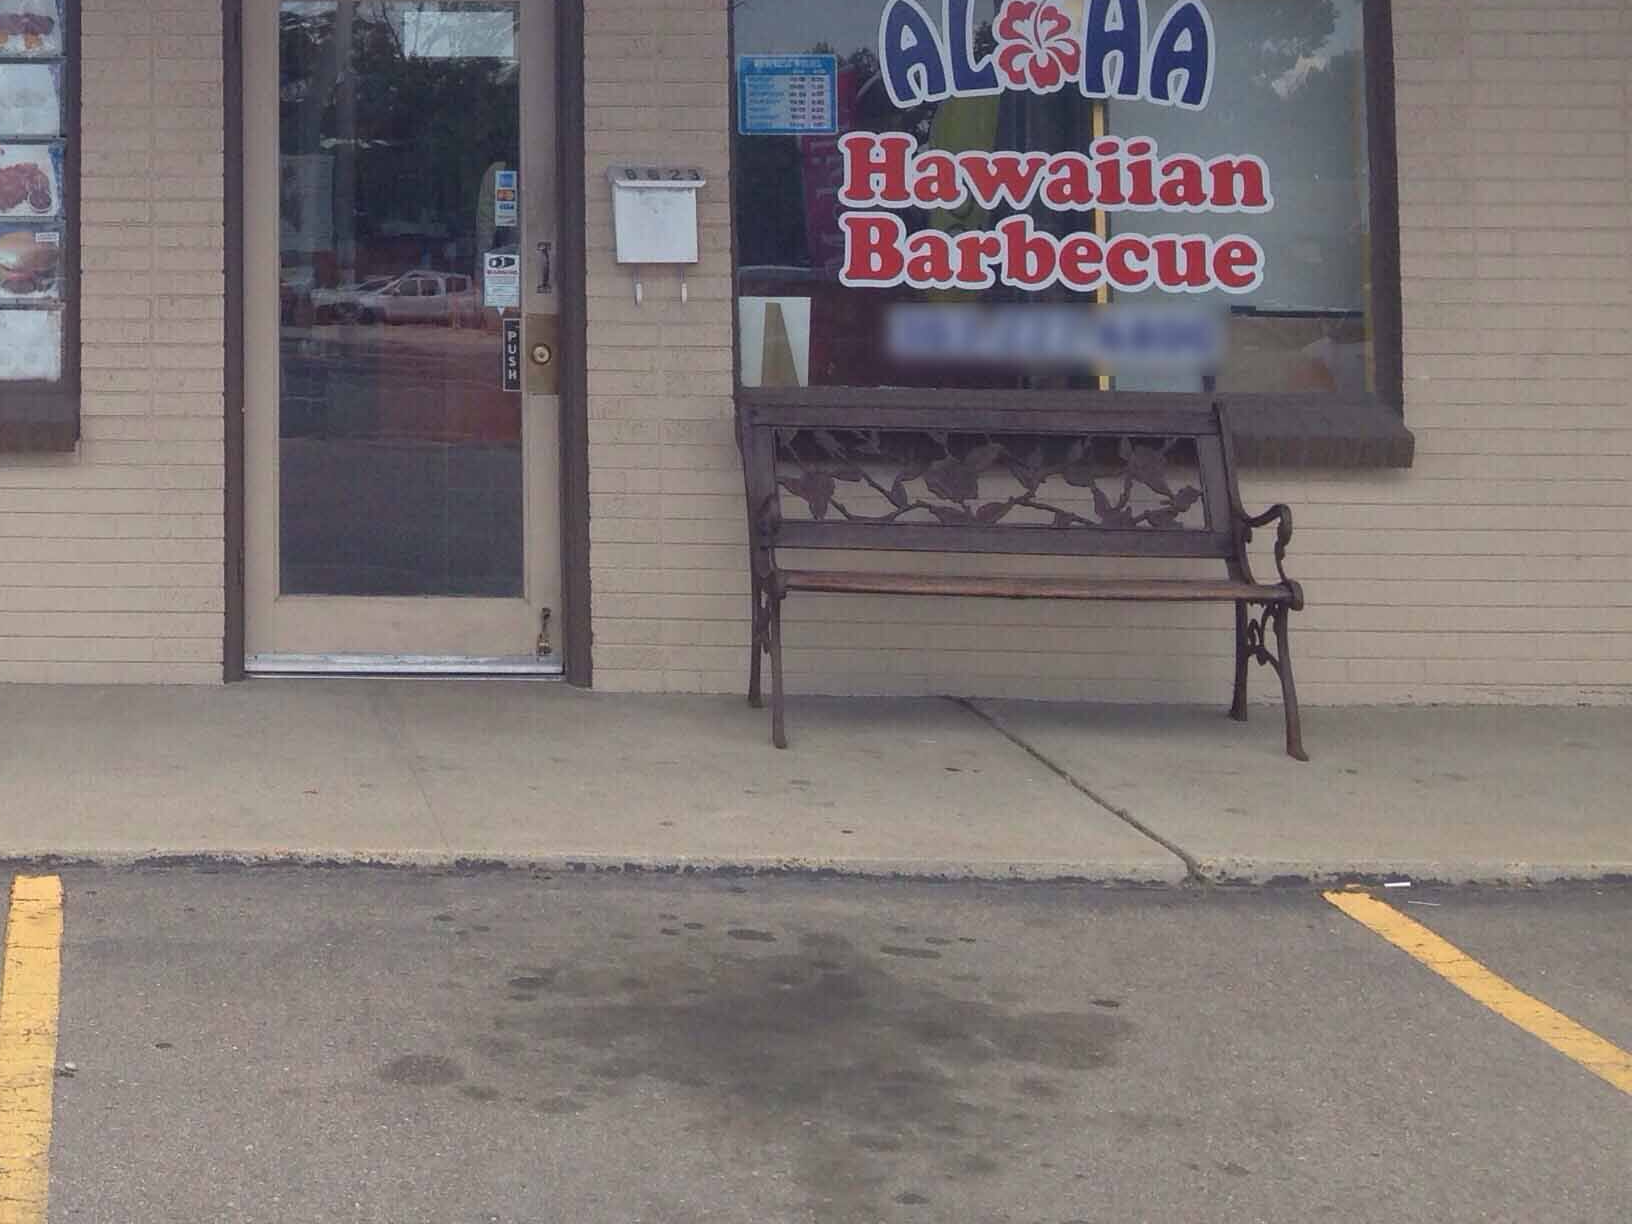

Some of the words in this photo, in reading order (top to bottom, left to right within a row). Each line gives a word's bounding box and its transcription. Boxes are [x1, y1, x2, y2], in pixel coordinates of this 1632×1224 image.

[839, 133, 1272, 213] Hawaiian
[839, 211, 1264, 292] Barbecue
[507, 330, 518, 380] PUSH
